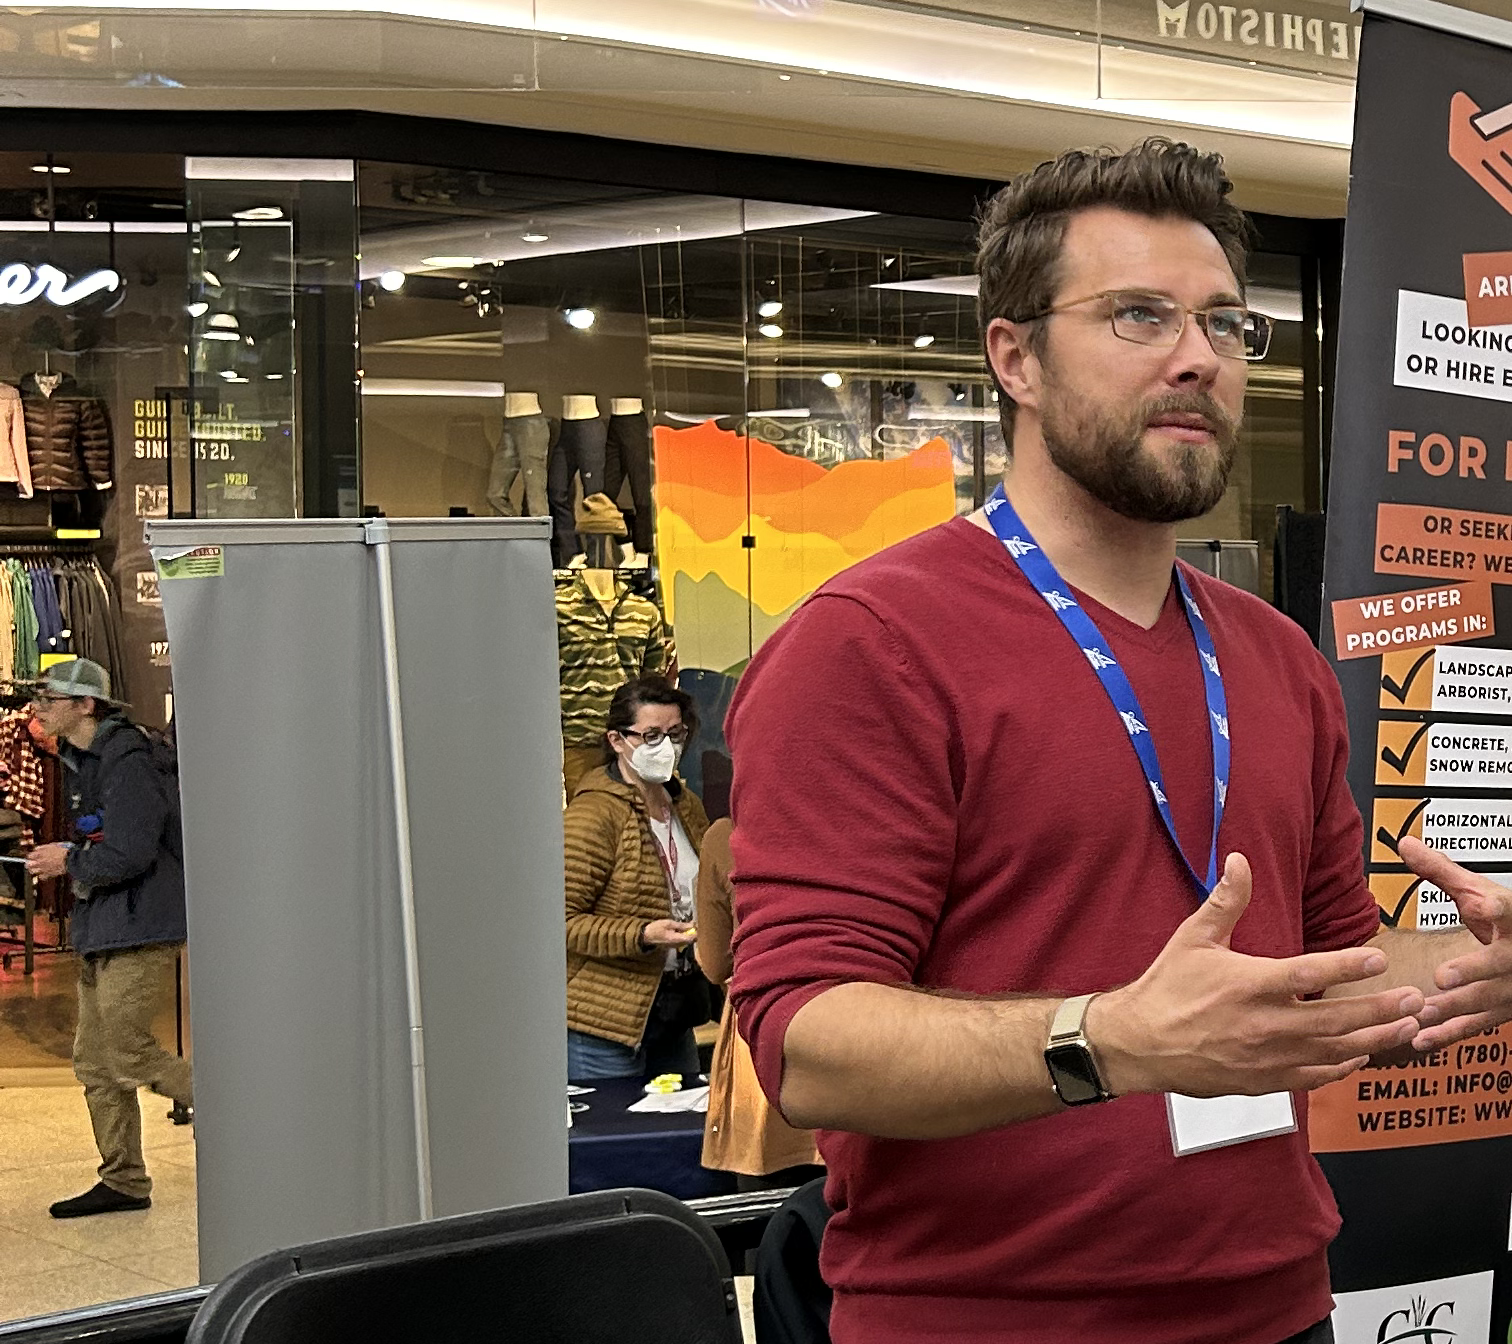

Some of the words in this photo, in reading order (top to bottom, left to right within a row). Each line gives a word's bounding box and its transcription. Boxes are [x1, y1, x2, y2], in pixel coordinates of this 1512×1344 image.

[1406, 355, 1439, 377] OR
[1445, 359, 1495, 385] HIRE
[1387, 429, 1486, 479] FOR
[1423, 515, 1453, 536] OR
[1379, 543, 1476, 572] CAREER?
[1360, 599, 1395, 618] WE
[1401, 589, 1462, 614] OFFER
[1346, 618, 1457, 652] PROGRAMS
[1463, 613, 1488, 634] IN:
[1437, 685, 1512, 704] ARBORIST,
[1431, 735, 1509, 755] CONCRETE,
[1429, 758, 1473, 774] SNOW
[1358, 1078, 1439, 1102] EMAIL:
[1358, 1107, 1467, 1133] WEBSITE:
